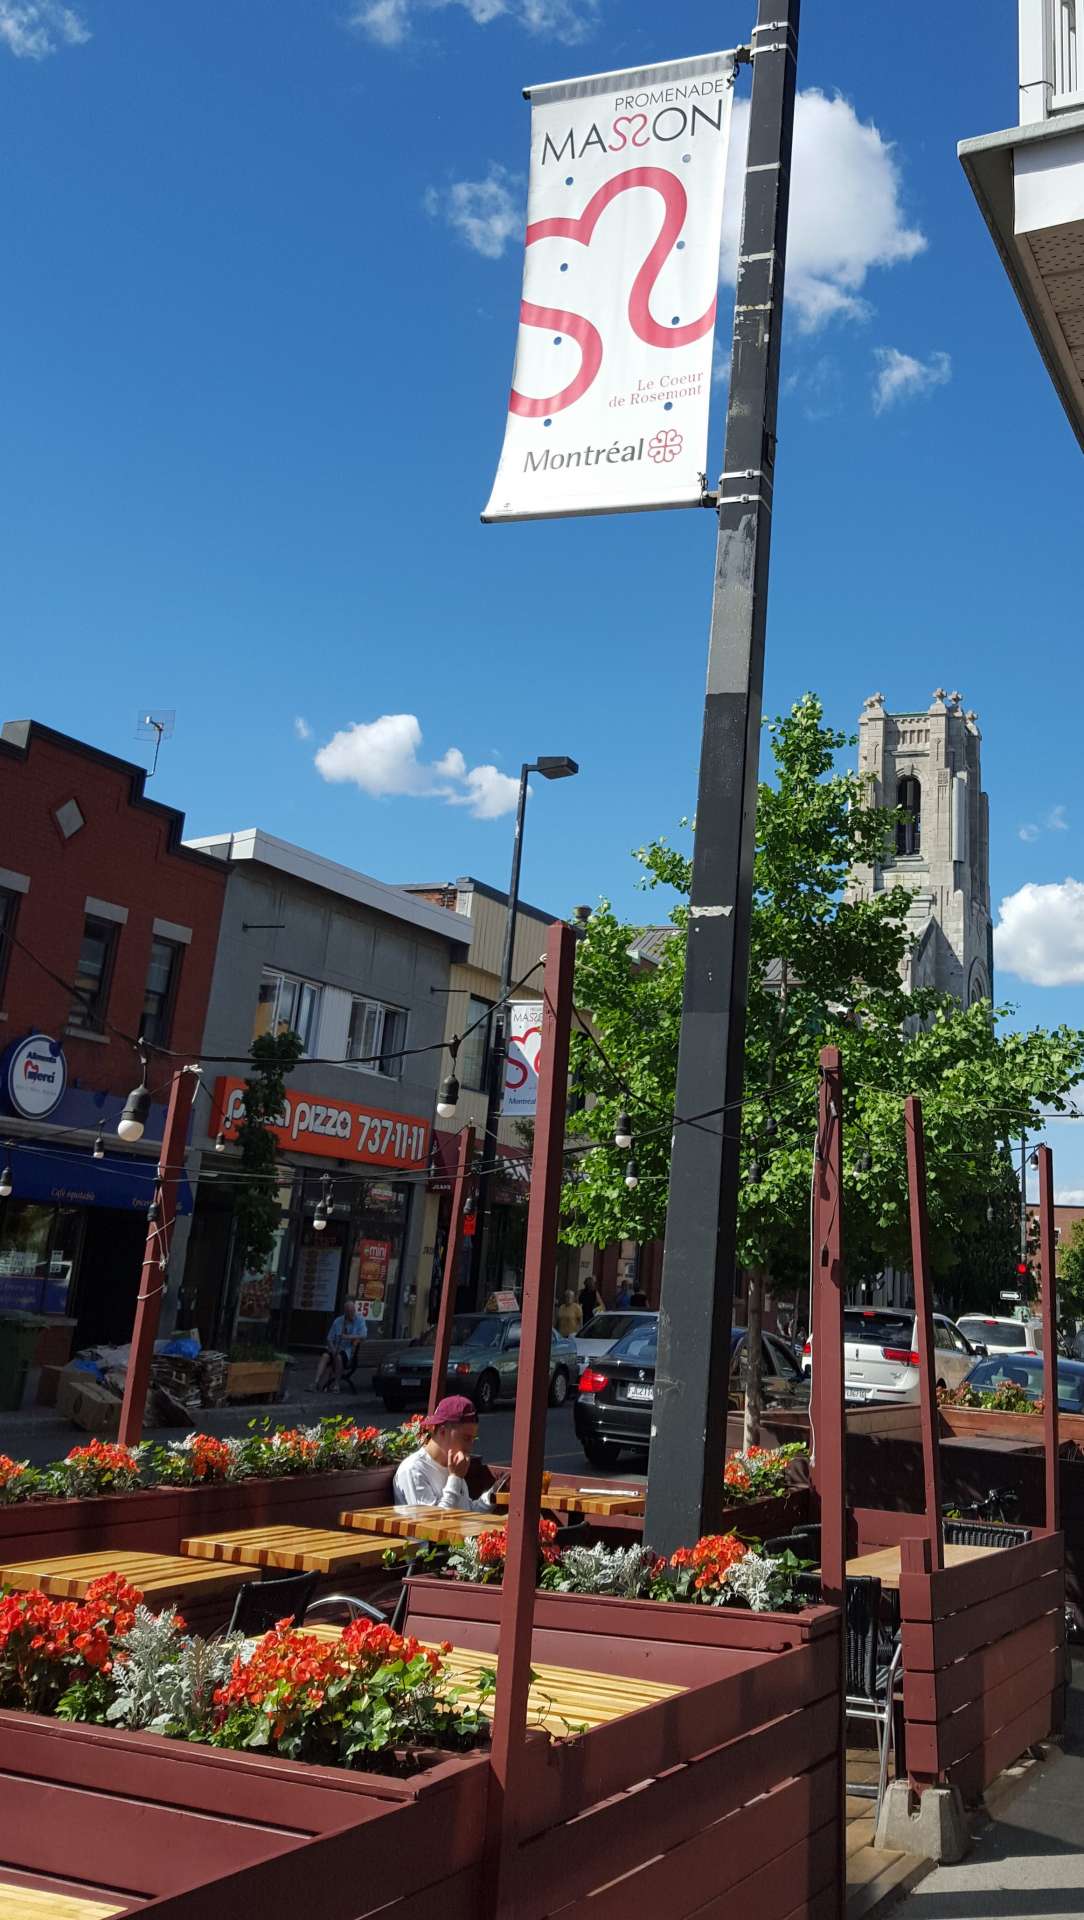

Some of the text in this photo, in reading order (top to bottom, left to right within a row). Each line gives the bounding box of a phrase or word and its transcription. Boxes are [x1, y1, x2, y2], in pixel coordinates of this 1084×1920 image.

[614, 78, 724, 111] PROMENADE
[541, 98, 722, 166] MASSON
[608, 384, 703, 408] de Rosemont
[637, 371, 704, 391] Le Coeur
[523, 437, 645, 473] Montréal
[291, 1101, 352, 1140] pizza
